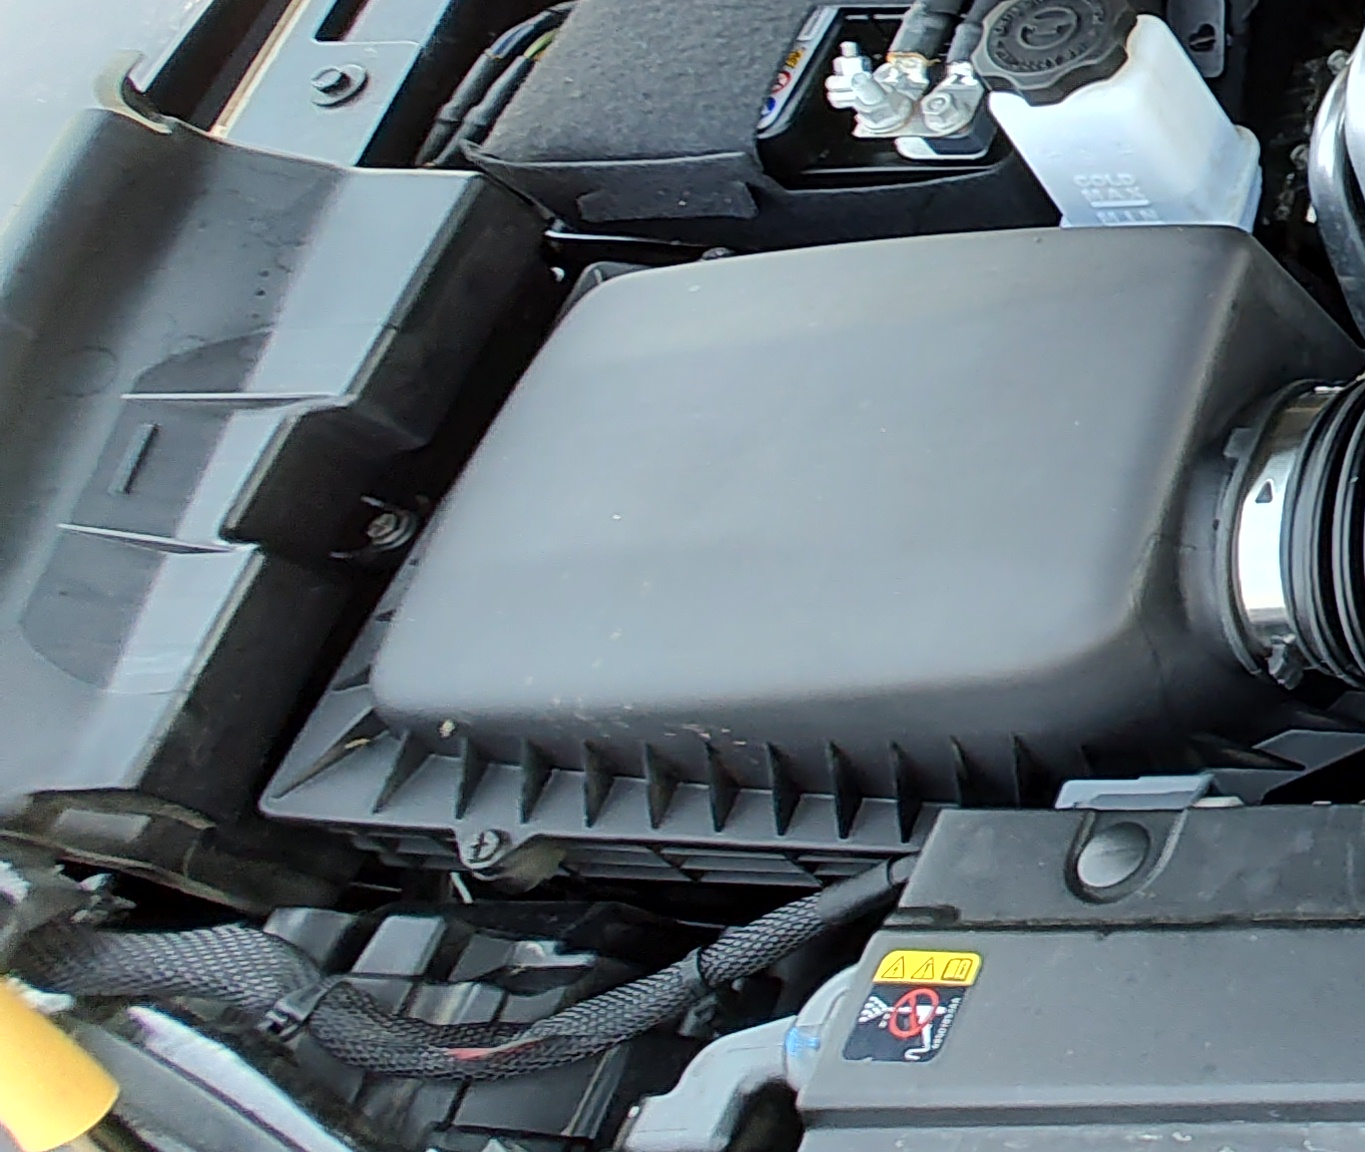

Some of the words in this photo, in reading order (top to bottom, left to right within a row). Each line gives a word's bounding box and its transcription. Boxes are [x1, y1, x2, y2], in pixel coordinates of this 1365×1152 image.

[1073, 173, 1135, 187] COLD
[1081, 187, 1147, 201] MAX
[1096, 208, 1160, 223] MIN
